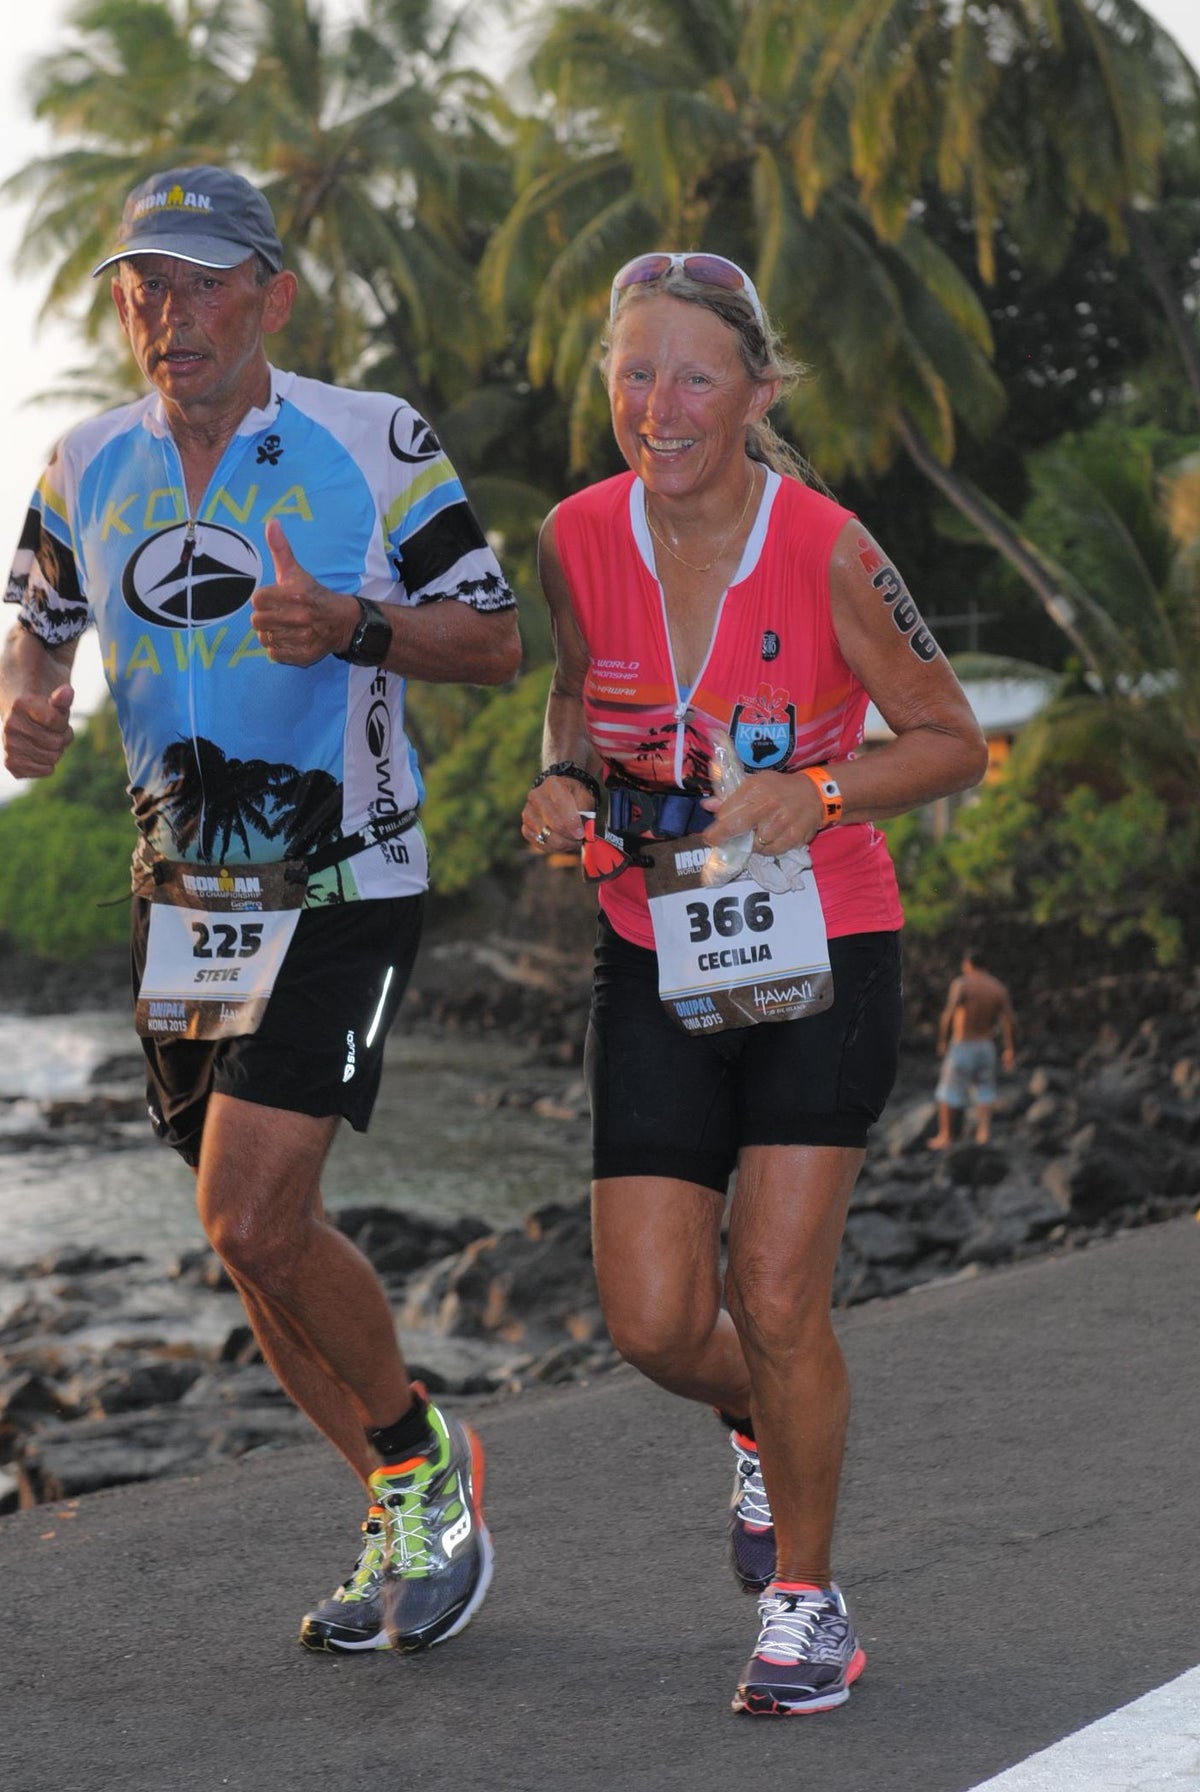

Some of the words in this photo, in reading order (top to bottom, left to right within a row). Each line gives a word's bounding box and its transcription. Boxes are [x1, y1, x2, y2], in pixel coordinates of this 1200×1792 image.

[101, 485, 314, 543] KONA
[873, 566, 938, 663] 366
[103, 627, 275, 684] HAWA
[597, 659, 640, 670] WORLD
[740, 726, 787, 741] KONA
[375, 758, 410, 865] WOS
[675, 847, 712, 870] IRON
[182, 868, 261, 893] IRONMAN
[686, 891, 774, 943] 366
[191, 922, 264, 958] 225
[698, 944, 772, 972] CECILIA
[193, 967, 241, 983] STEVE
[147, 1019, 169, 1031] KONA
[169, 1019, 189, 1032] 2015
[700, 1012, 724, 1028] 2015
